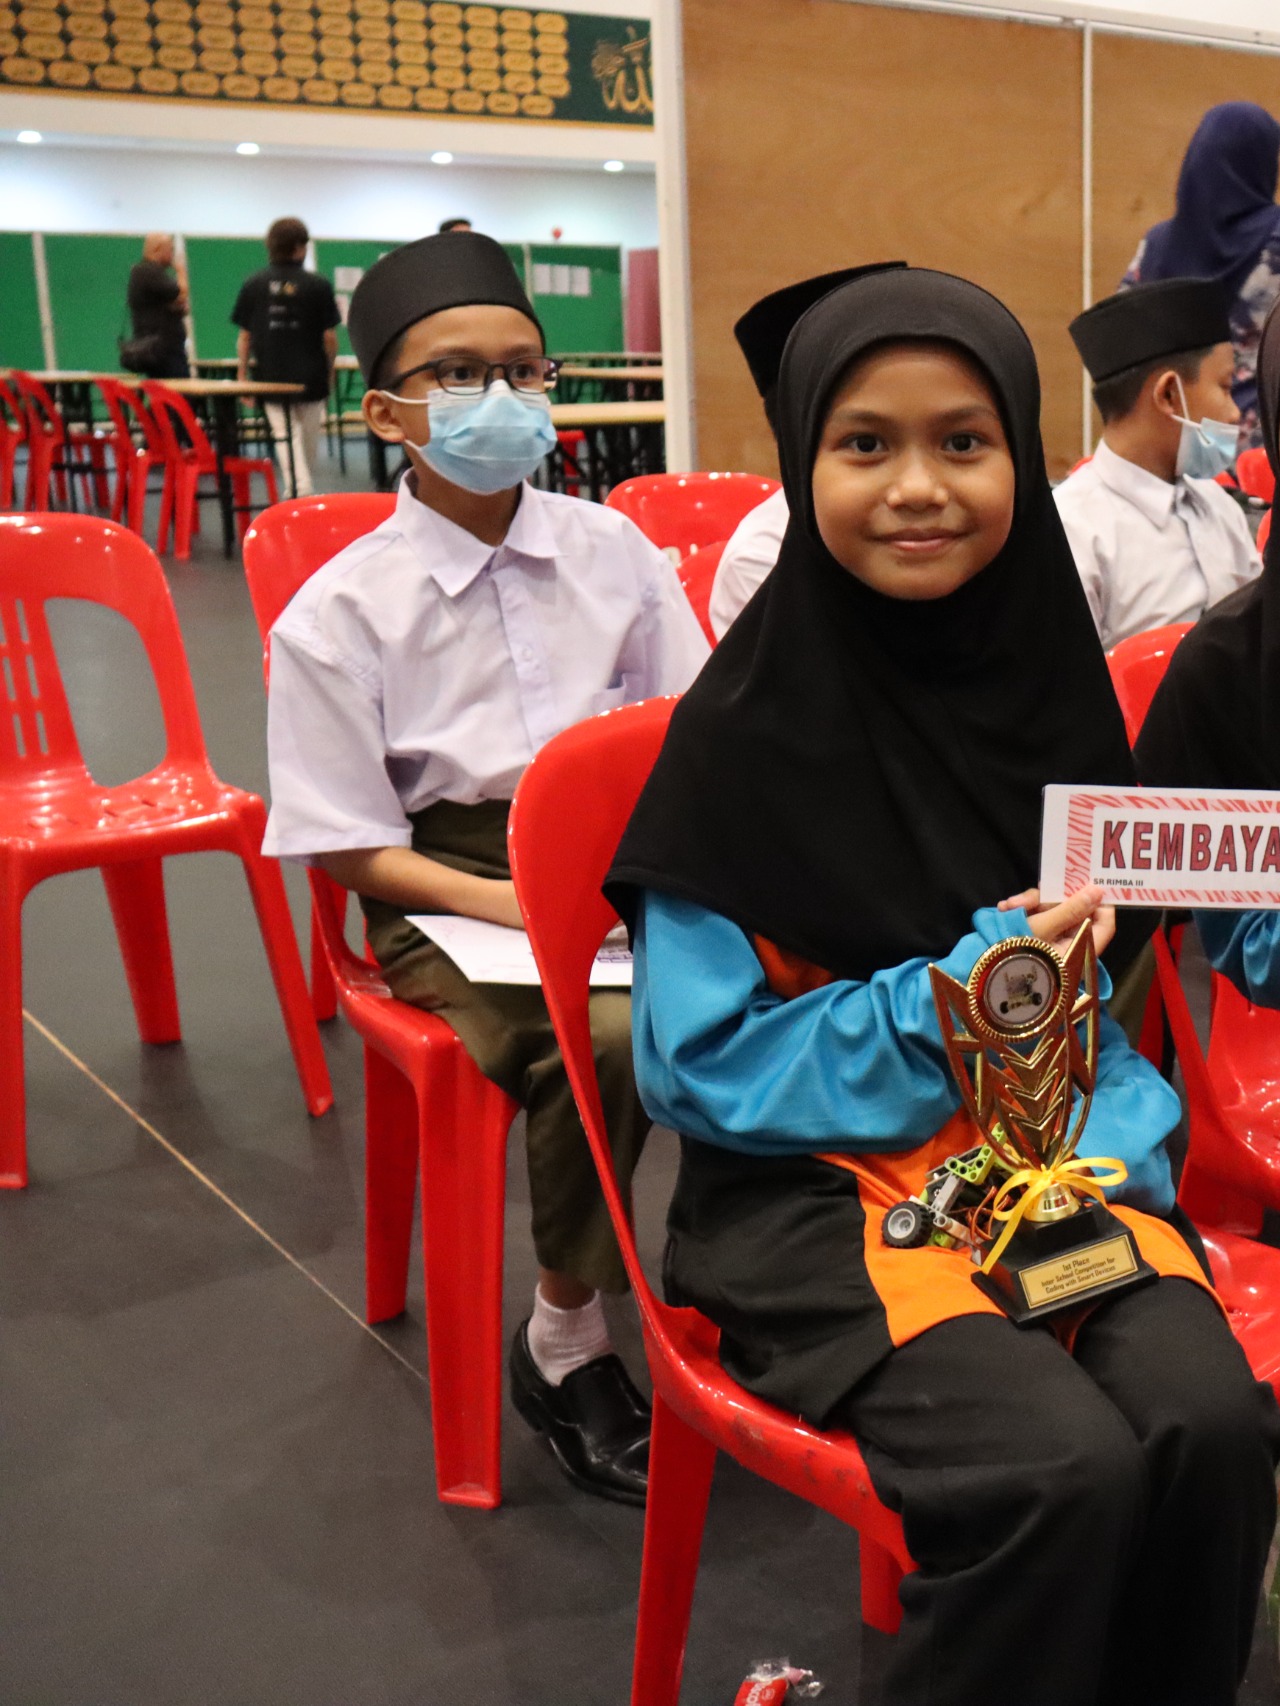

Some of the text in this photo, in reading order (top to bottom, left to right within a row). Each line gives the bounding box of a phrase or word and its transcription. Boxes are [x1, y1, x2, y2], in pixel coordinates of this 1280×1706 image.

[1093, 877, 1144, 887] SR RIMBA III
[1072, 1257, 1090, 1268] Place
[1041, 1278, 1054, 1287] Inter
[1055, 1271, 1074, 1282] School
[1074, 1260, 1106, 1275] Competition
[1045, 1265, 1116, 1293] Coding with Smart Devices
